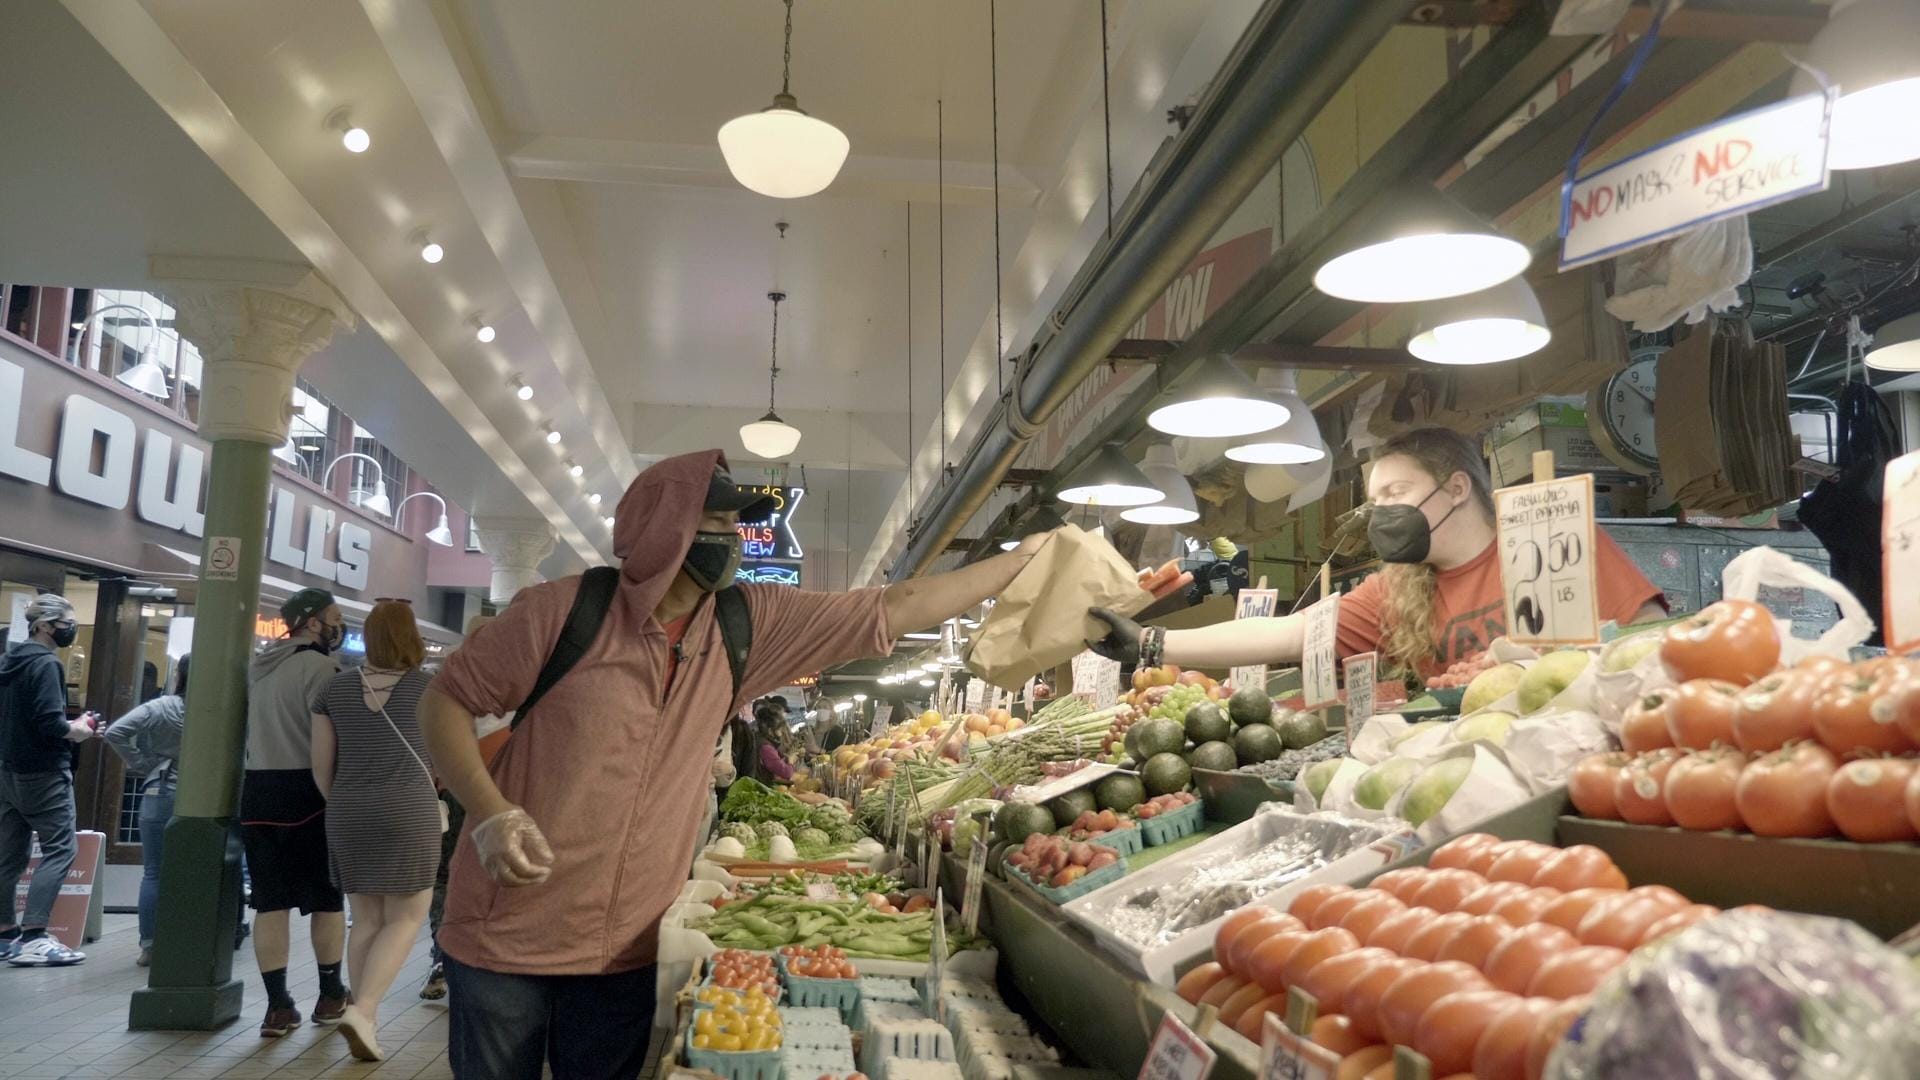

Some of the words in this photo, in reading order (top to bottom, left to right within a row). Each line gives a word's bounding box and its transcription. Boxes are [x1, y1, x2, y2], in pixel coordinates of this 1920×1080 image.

[1570, 187, 1614, 230] NO
[1615, 154, 1687, 214] MASK?
[1694, 140, 1753, 187] NO
[1705, 153, 1801, 208] SERVICE
[0, 356, 372, 592] LOWLL'S
[1512, 486, 1569, 511] FABULOUS
[1500, 509, 1531, 526] SWEET
[1535, 500, 1581, 521] PAPAYA
[736, 527, 773, 543] AILS
[744, 541, 775, 556] IEW
[1557, 586, 1575, 603] LB
